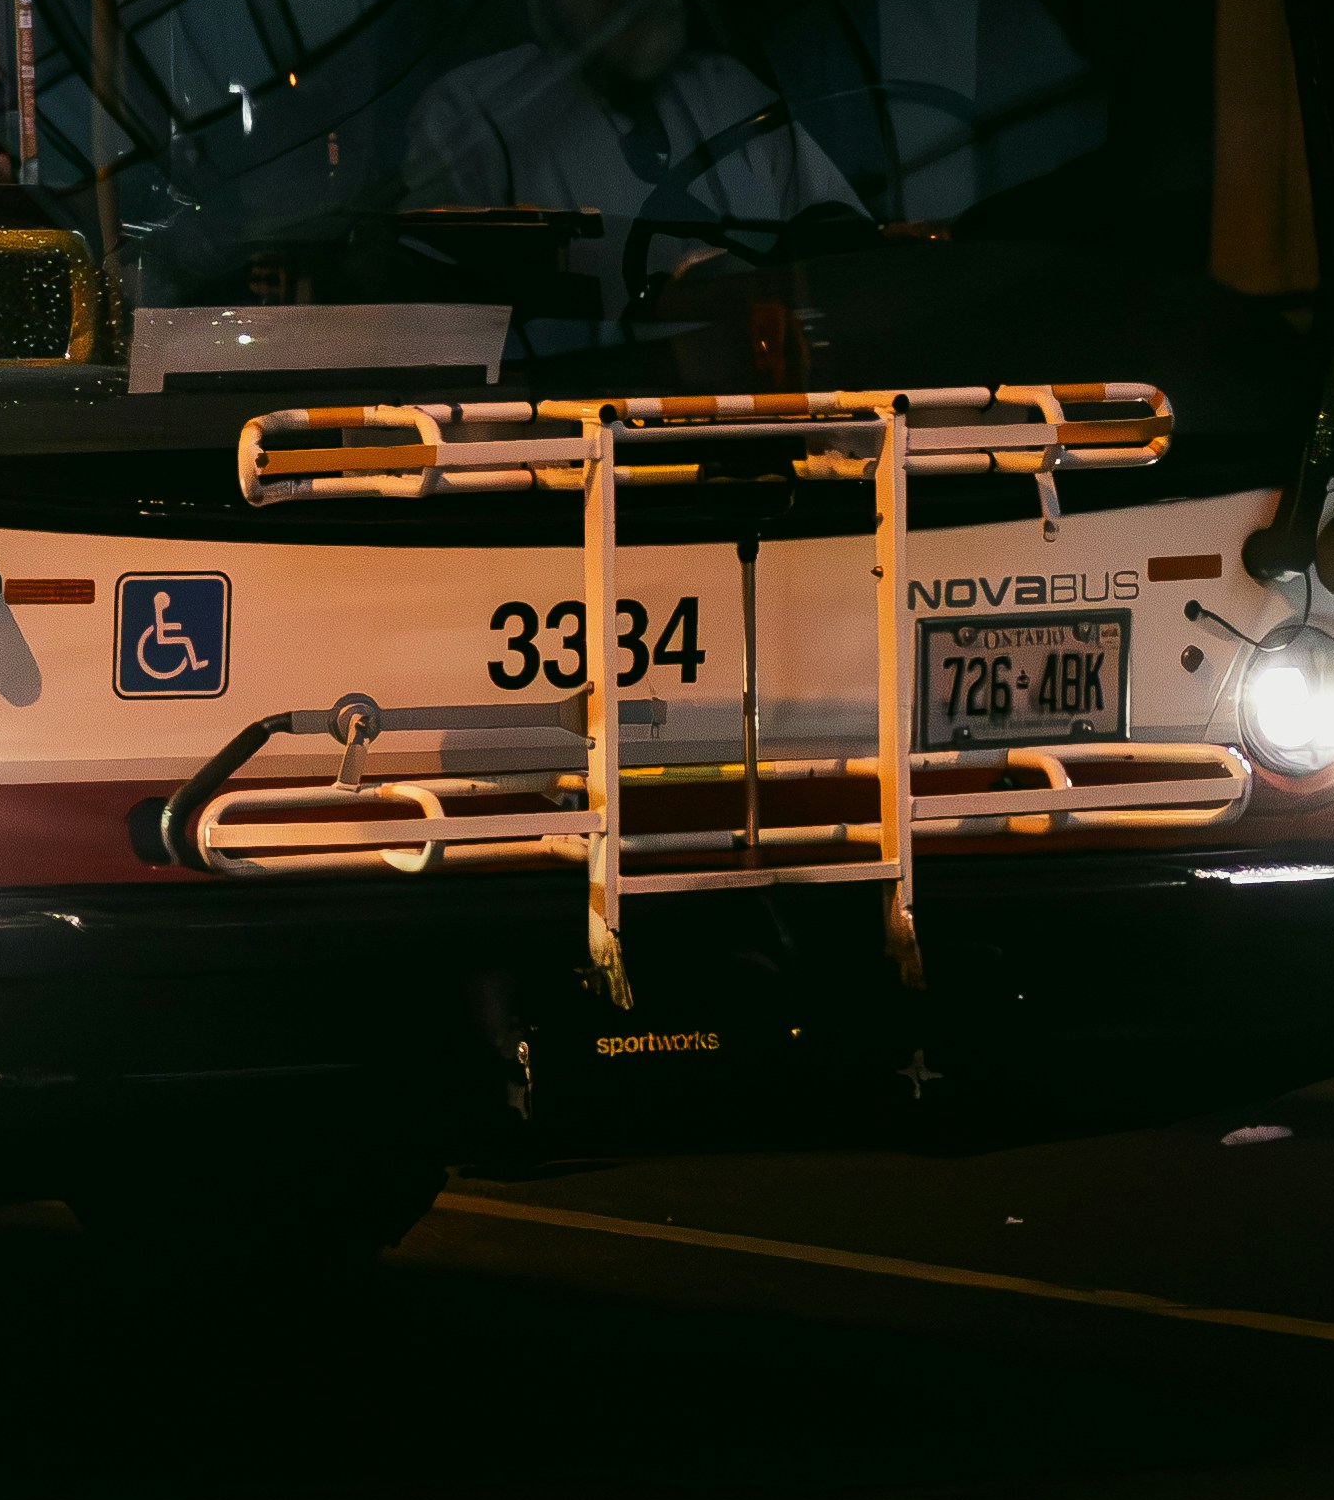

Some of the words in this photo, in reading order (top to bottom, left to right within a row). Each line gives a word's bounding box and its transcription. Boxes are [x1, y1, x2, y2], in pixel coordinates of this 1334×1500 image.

[487, 596, 706, 690] 3334
[983, 627, 1066, 650] ONTARIO
[942, 655, 1013, 718] 726
[596, 1031, 720, 1057] sportworks
